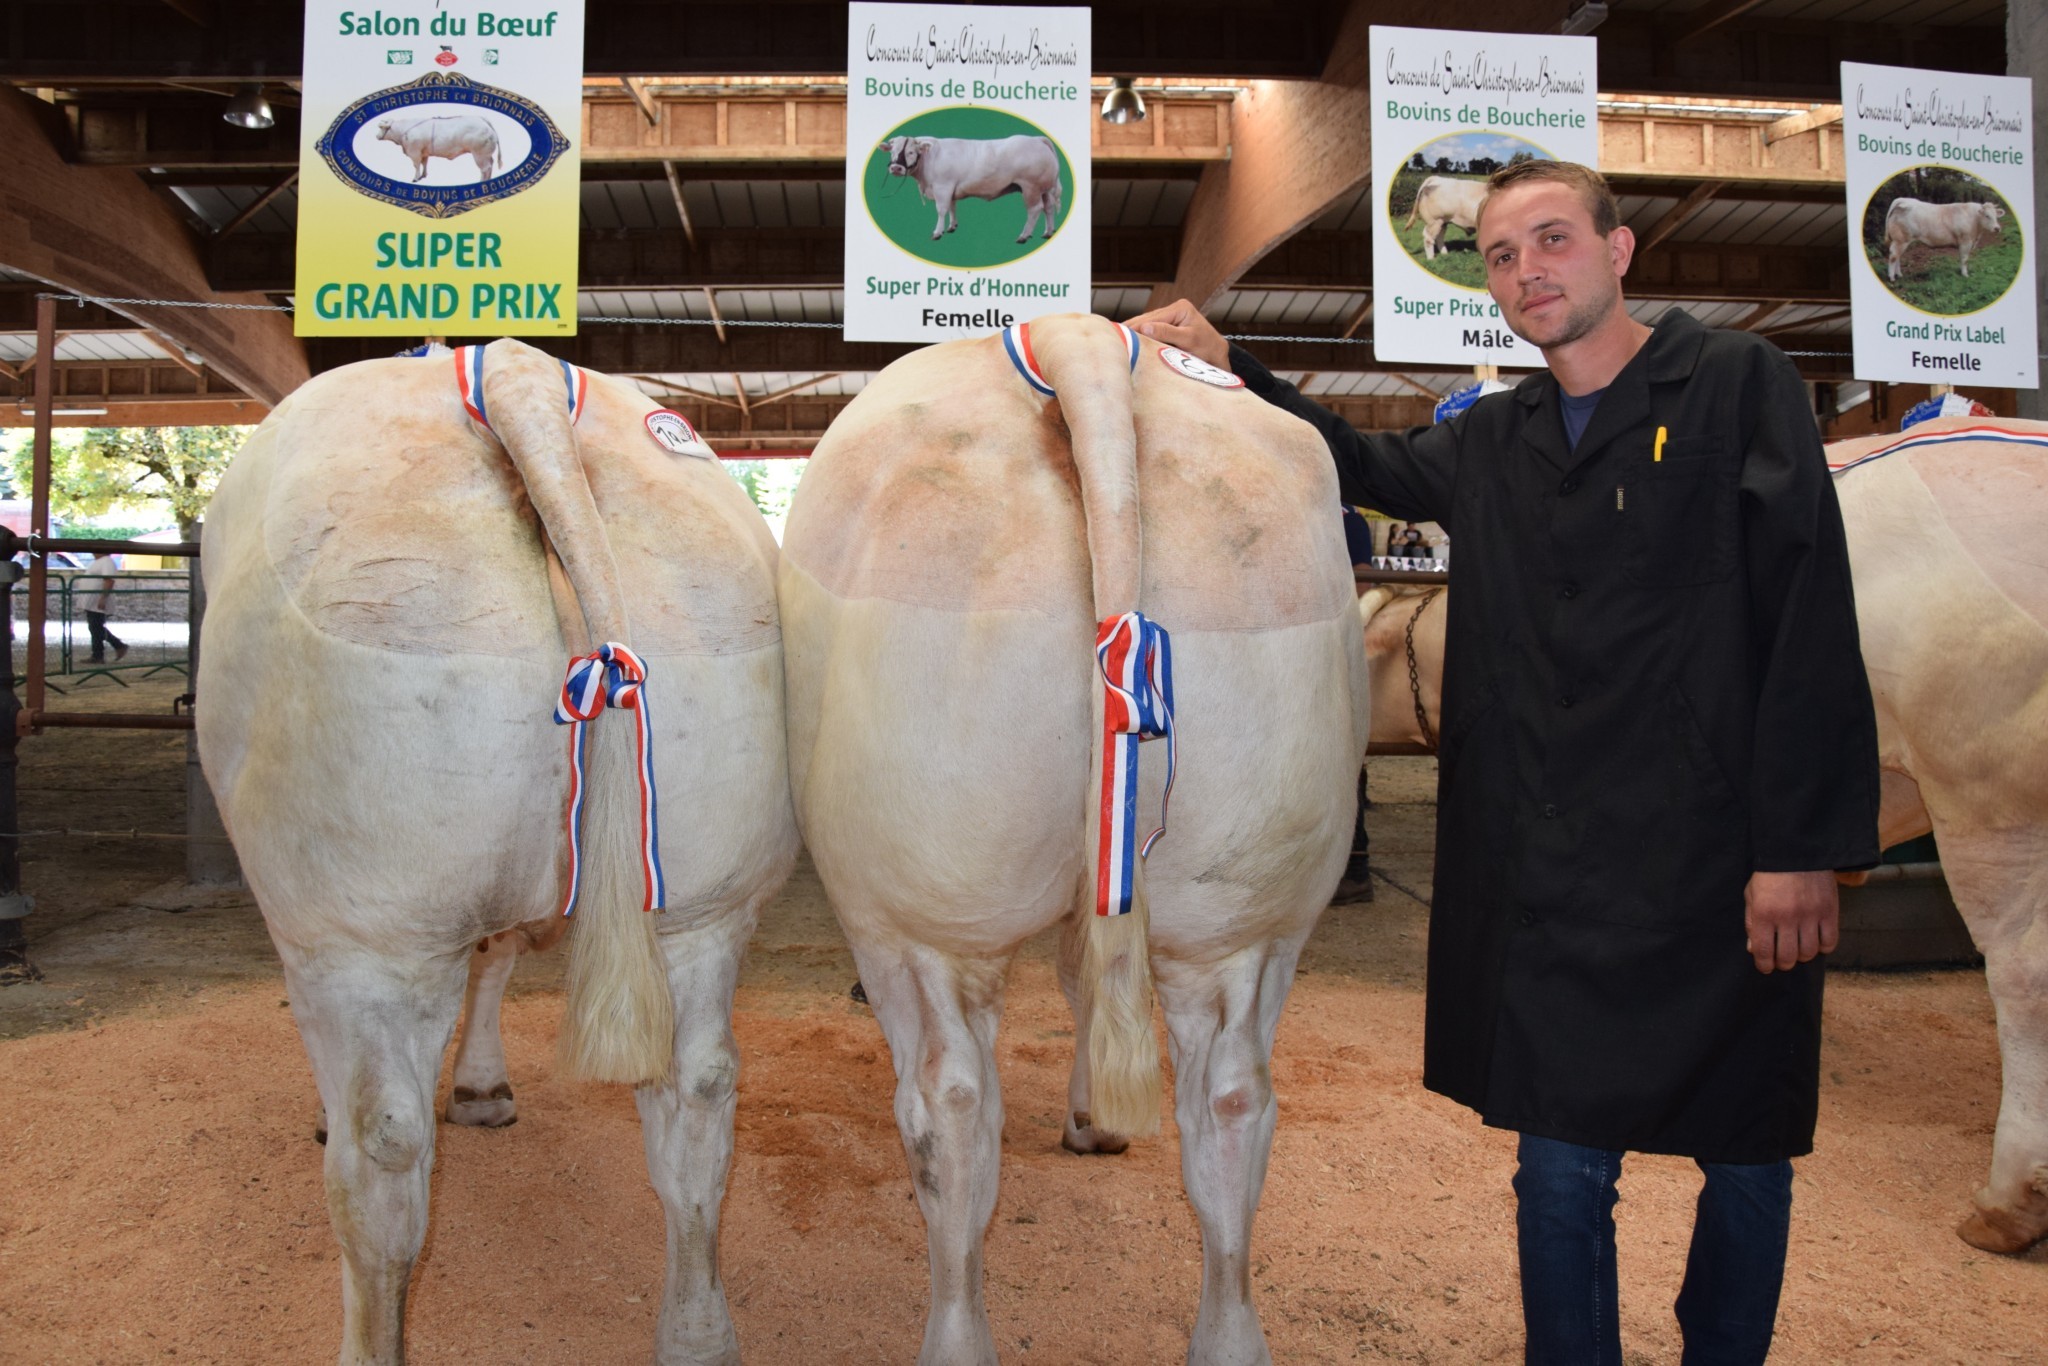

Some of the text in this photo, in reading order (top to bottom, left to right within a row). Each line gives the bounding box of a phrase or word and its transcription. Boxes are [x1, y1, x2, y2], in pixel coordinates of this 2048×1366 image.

[339, 11, 558, 37] Salon du Bœuf
[867, 23, 910, 62] Concours
[912, 32, 923, 63] de
[1386, 47, 1428, 87] Concours
[1430, 56, 1440, 88] de
[865, 77, 1077, 101] Bovins de Boucherie
[1857, 83, 1892, 122] Concours
[1893, 93, 1902, 123] de
[354, 110, 368, 124] ST
[374, 90, 448, 111] CHRISTOPHE
[473, 93, 536, 127] BRIONNAIS
[1387, 100, 1586, 128] Bovins de Boucherie
[1858, 134, 2023, 165] Bovins de Boucherie
[337, 149, 543, 200] CONCOURS DE BOVINS DE BOUCHERIE
[376, 232, 502, 269] SUPER
[315, 283, 562, 319] GRAND PRIX
[866, 276, 920, 299] Super
[927, 277, 963, 296] Prix
[922, 309, 1014, 328] Femelle
[1394, 296, 1444, 319] Super
[1450, 298, 1484, 317] Prix
[1463, 329, 1514, 348] Mâle
[1886, 321, 2005, 344] Grand Prix Label
[1912, 351, 1981, 371] Femelle
